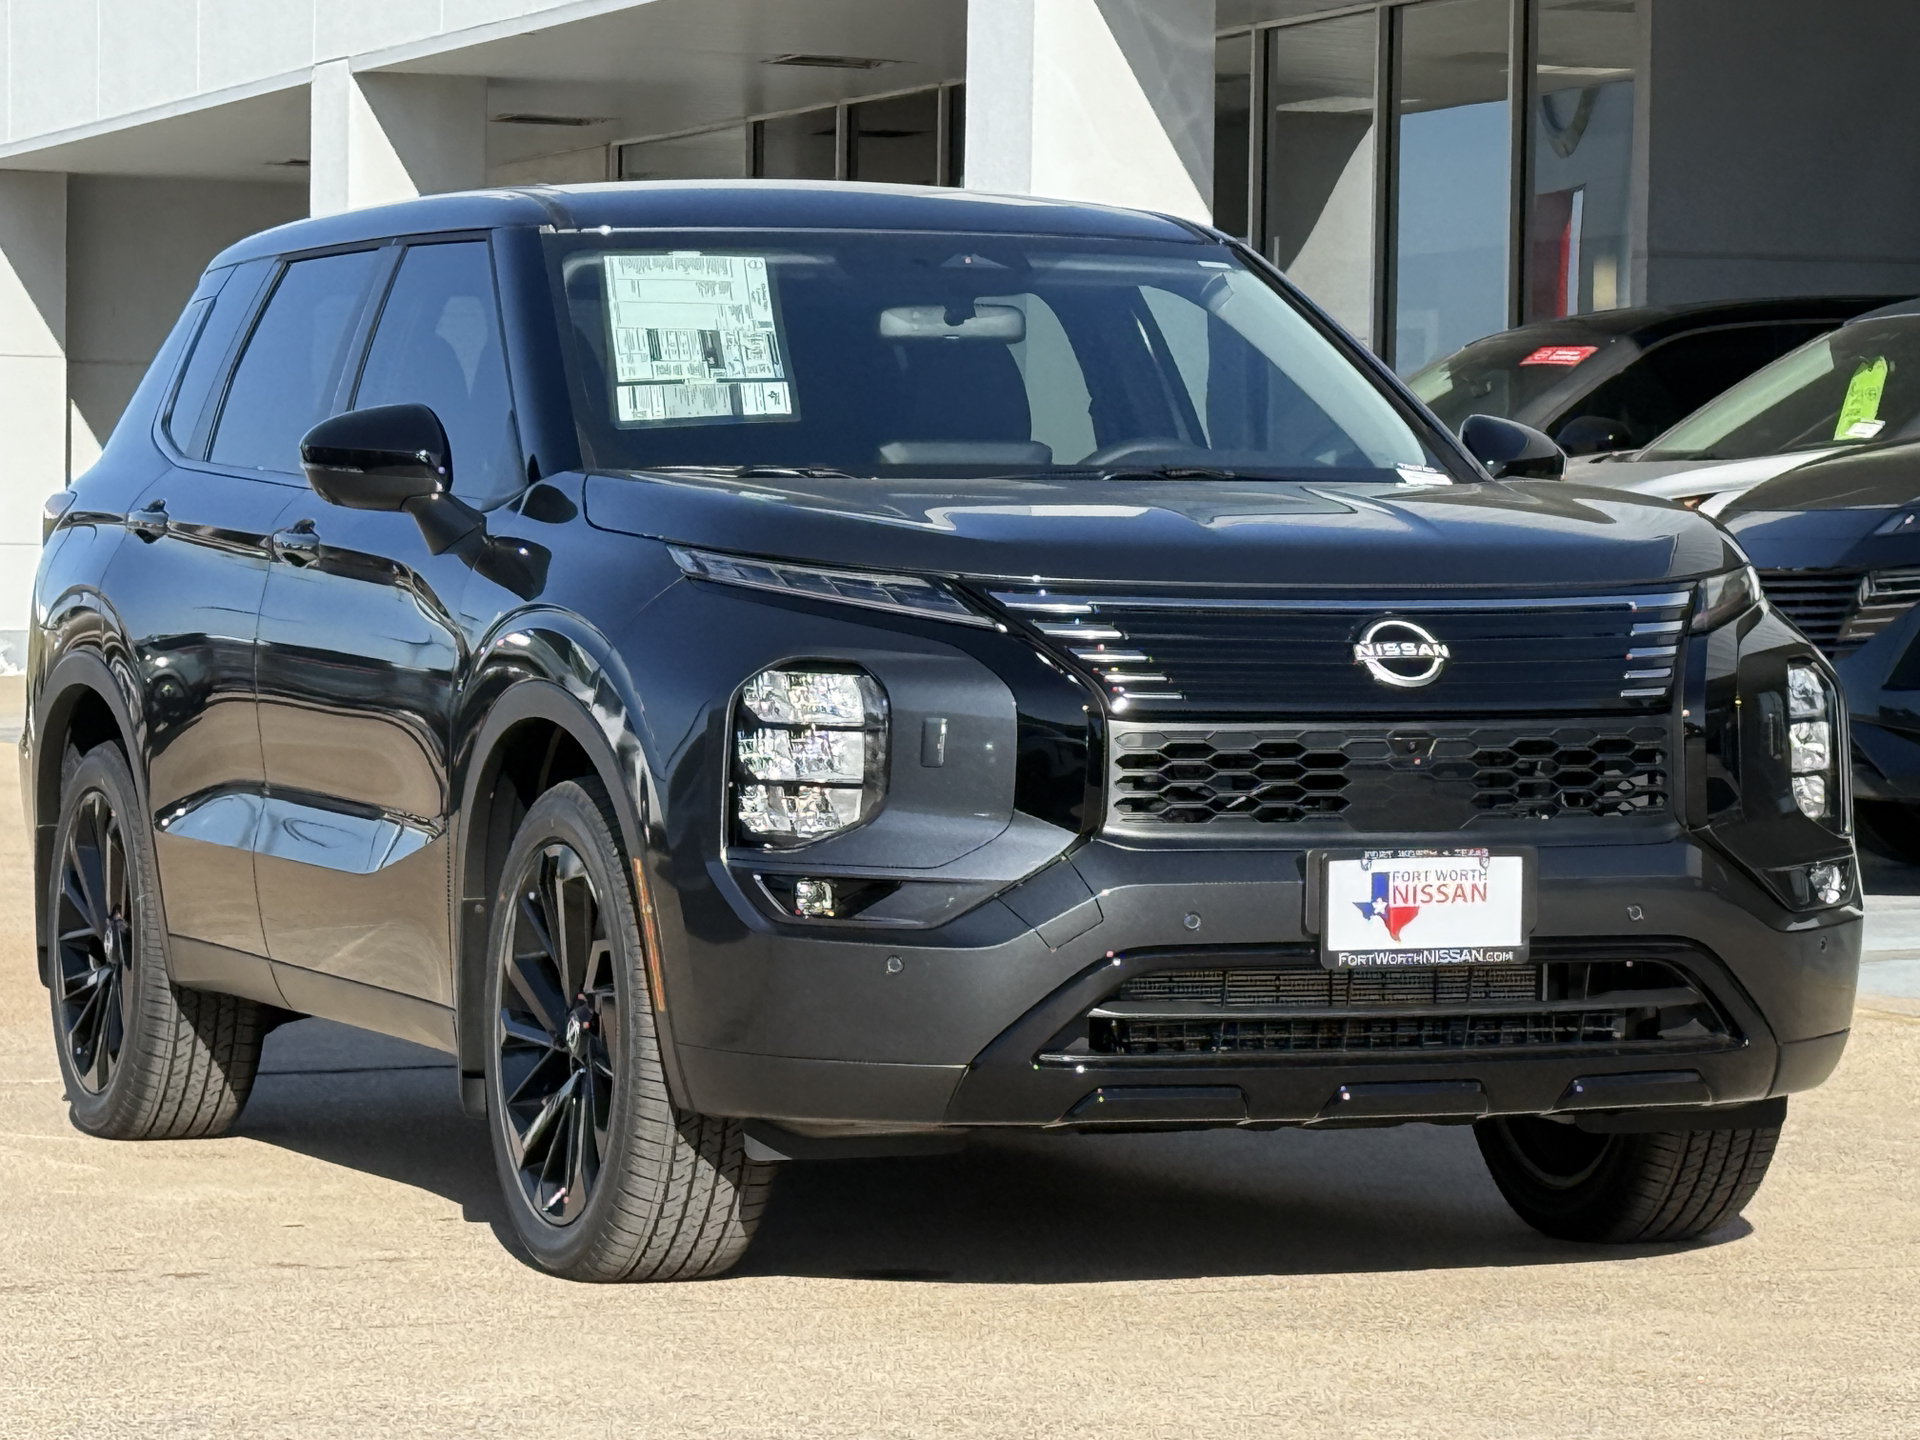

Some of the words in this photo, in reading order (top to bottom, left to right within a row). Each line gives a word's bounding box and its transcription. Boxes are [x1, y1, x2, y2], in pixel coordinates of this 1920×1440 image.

[1354, 642, 1450, 659] NISSAN
[1392, 870, 1430, 883] FORT
[1435, 868, 1488, 882] WORTH
[1392, 882, 1488, 905] NISSAN
